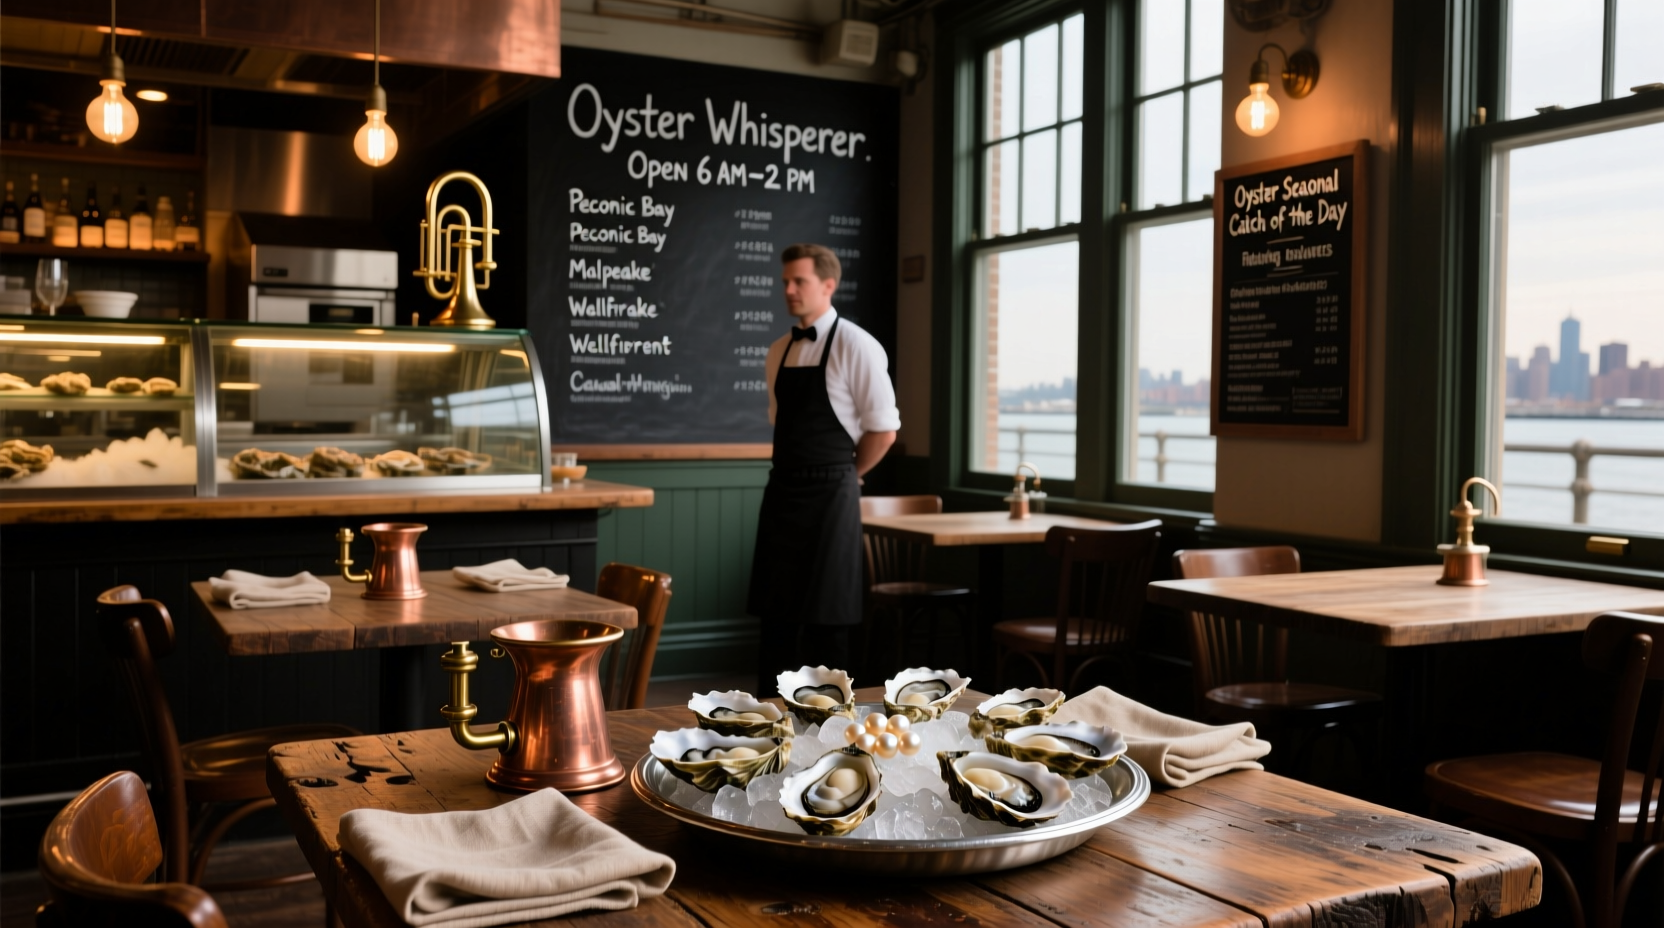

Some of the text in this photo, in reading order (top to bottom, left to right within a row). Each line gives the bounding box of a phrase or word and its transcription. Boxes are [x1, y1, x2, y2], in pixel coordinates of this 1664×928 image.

[567, 83, 695, 153] Oyster
[697, 155, 712, 185] 6
[786, 168, 815, 194] PM
[569, 187, 675, 228] Peconic Bay
[1234, 181, 1280, 213] Oyster
[1270, 205, 1287, 234] of
[1288, 202, 1314, 227] the
[1317, 198, 1348, 231] Day
[570, 222, 667, 253] Peconic Bay
[568, 258, 652, 290] Malpeake
